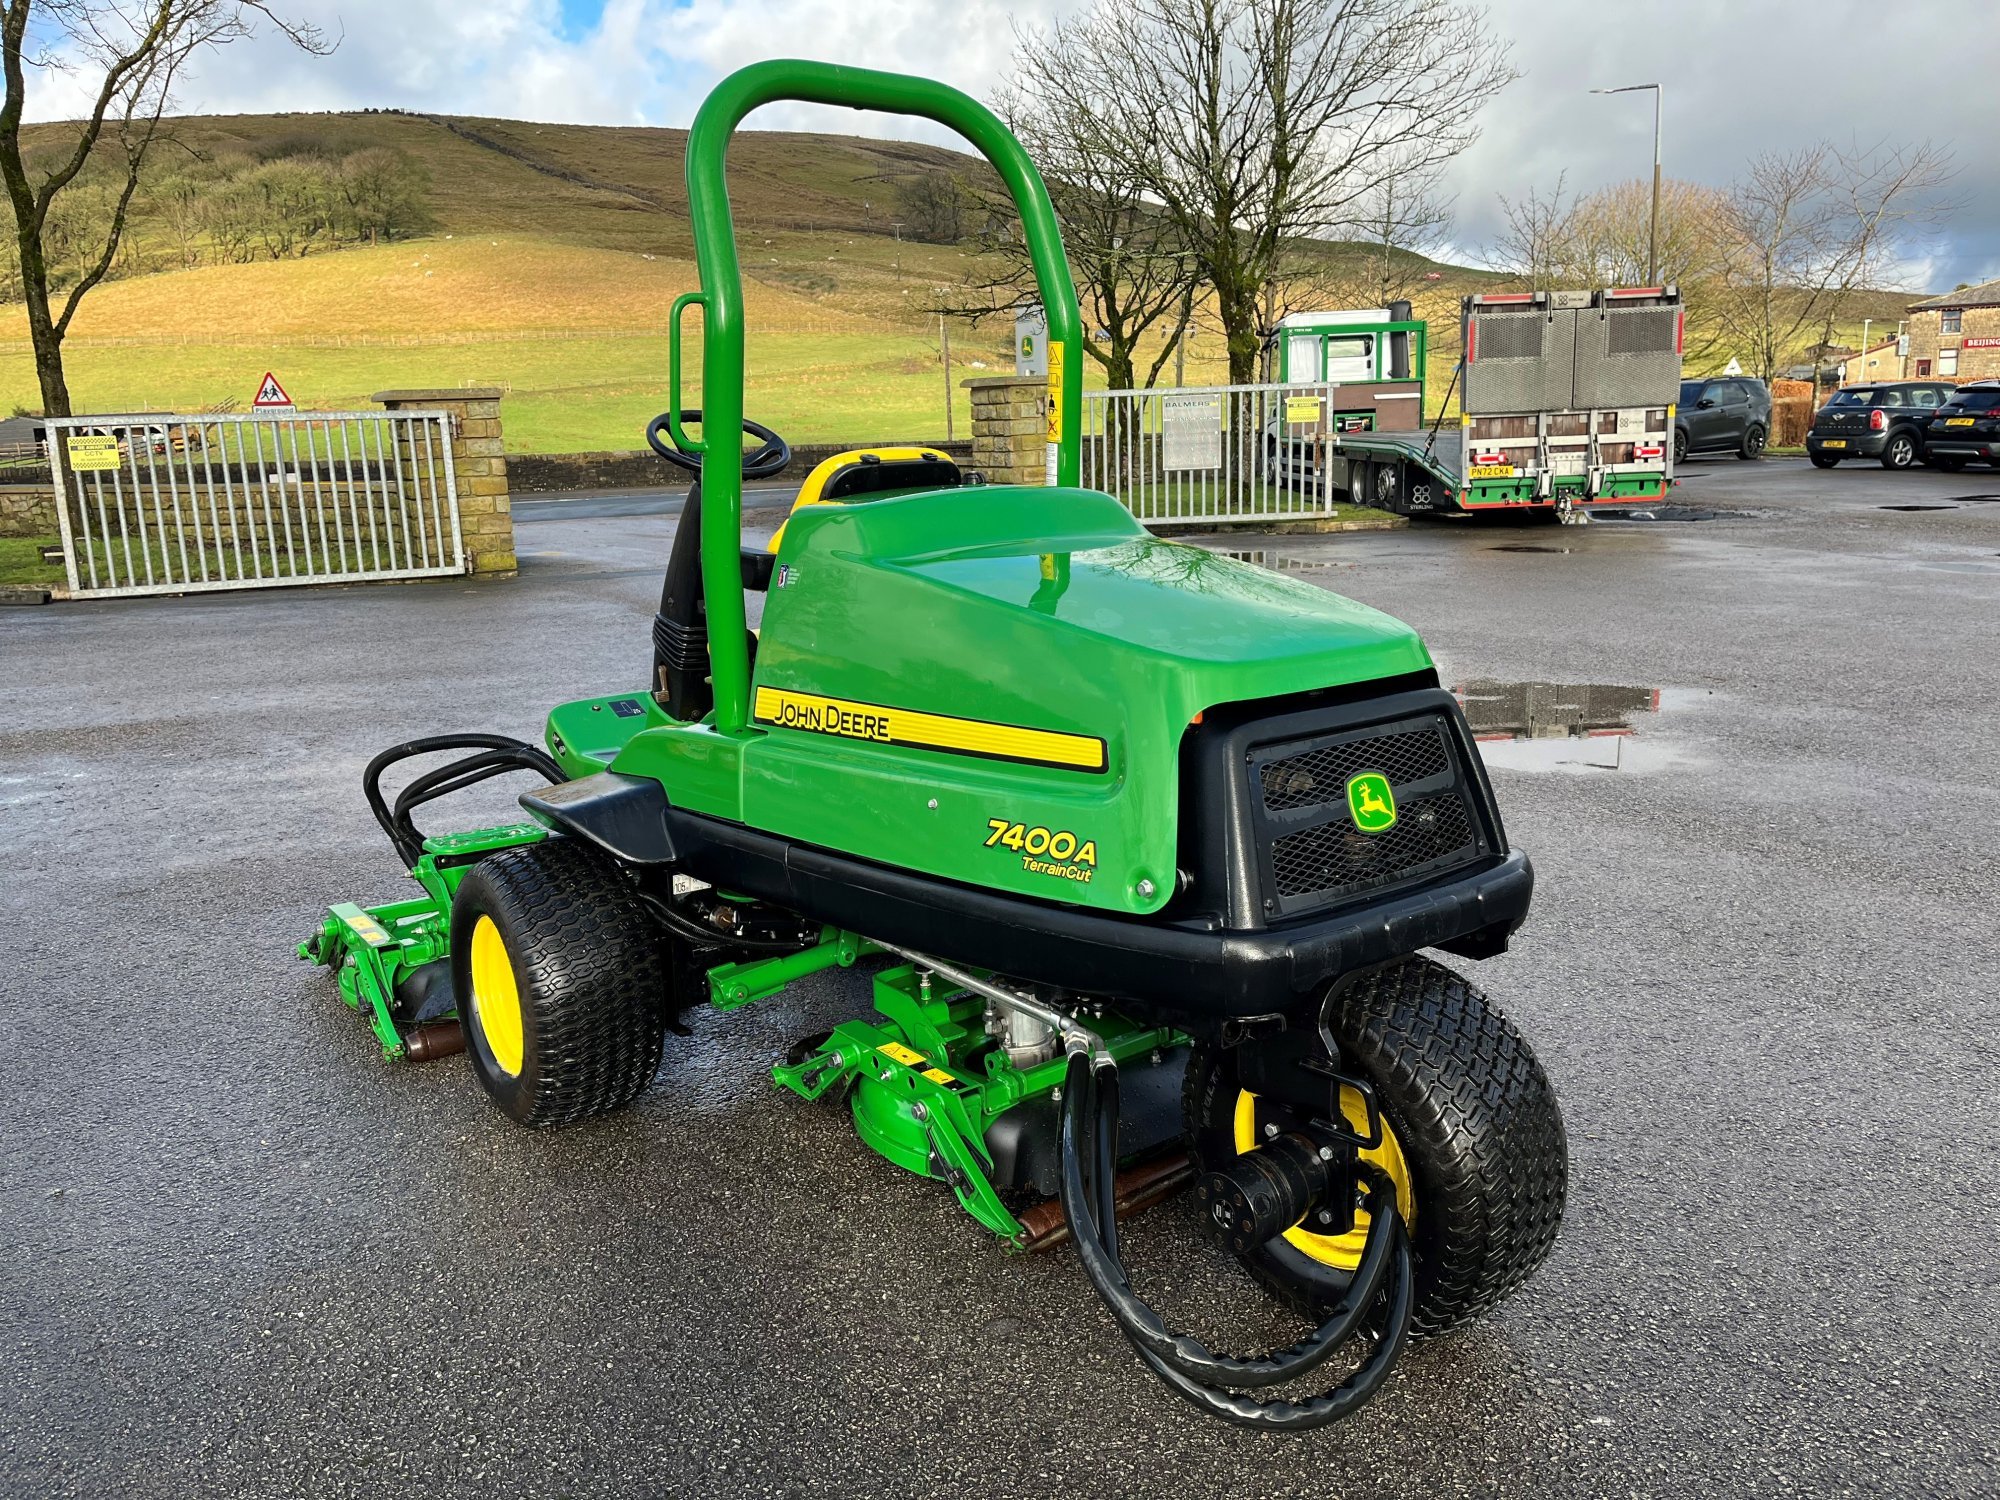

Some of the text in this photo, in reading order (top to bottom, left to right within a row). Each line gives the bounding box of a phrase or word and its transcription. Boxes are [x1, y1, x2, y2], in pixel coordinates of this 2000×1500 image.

[1967, 338, 2000, 347] BEIJING
[1471, 467, 1493, 476] PN72
[774, 698, 890, 738] JOHN DEERE
[1021, 855, 1093, 883] TerrainCut
[674, 881, 686, 893] 105
